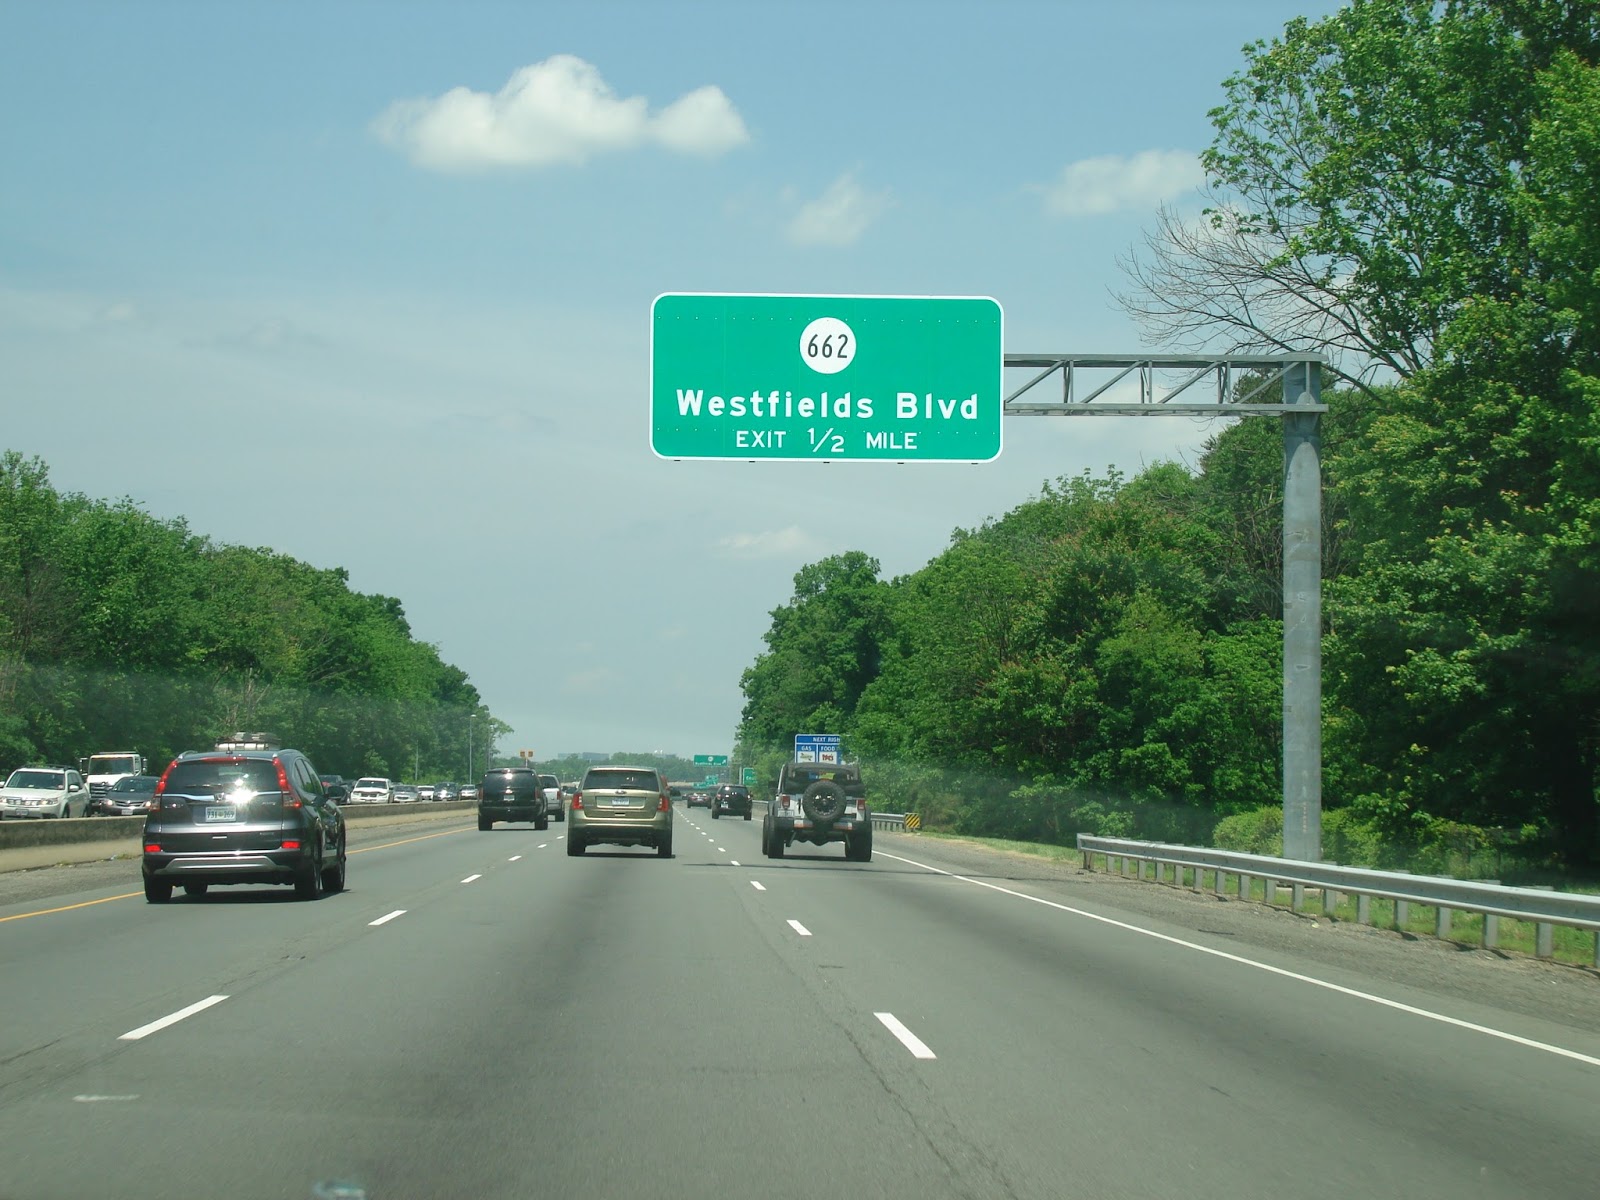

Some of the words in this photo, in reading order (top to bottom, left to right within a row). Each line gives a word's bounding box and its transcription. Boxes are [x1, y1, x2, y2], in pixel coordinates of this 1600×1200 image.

[808, 334, 848, 358] 662
[676, 389, 874, 419] Westfields
[896, 392, 978, 420] Blvd
[736, 430, 786, 448] EXIT
[808, 427, 845, 453] 1/2
[866, 432, 918, 450] MILE
